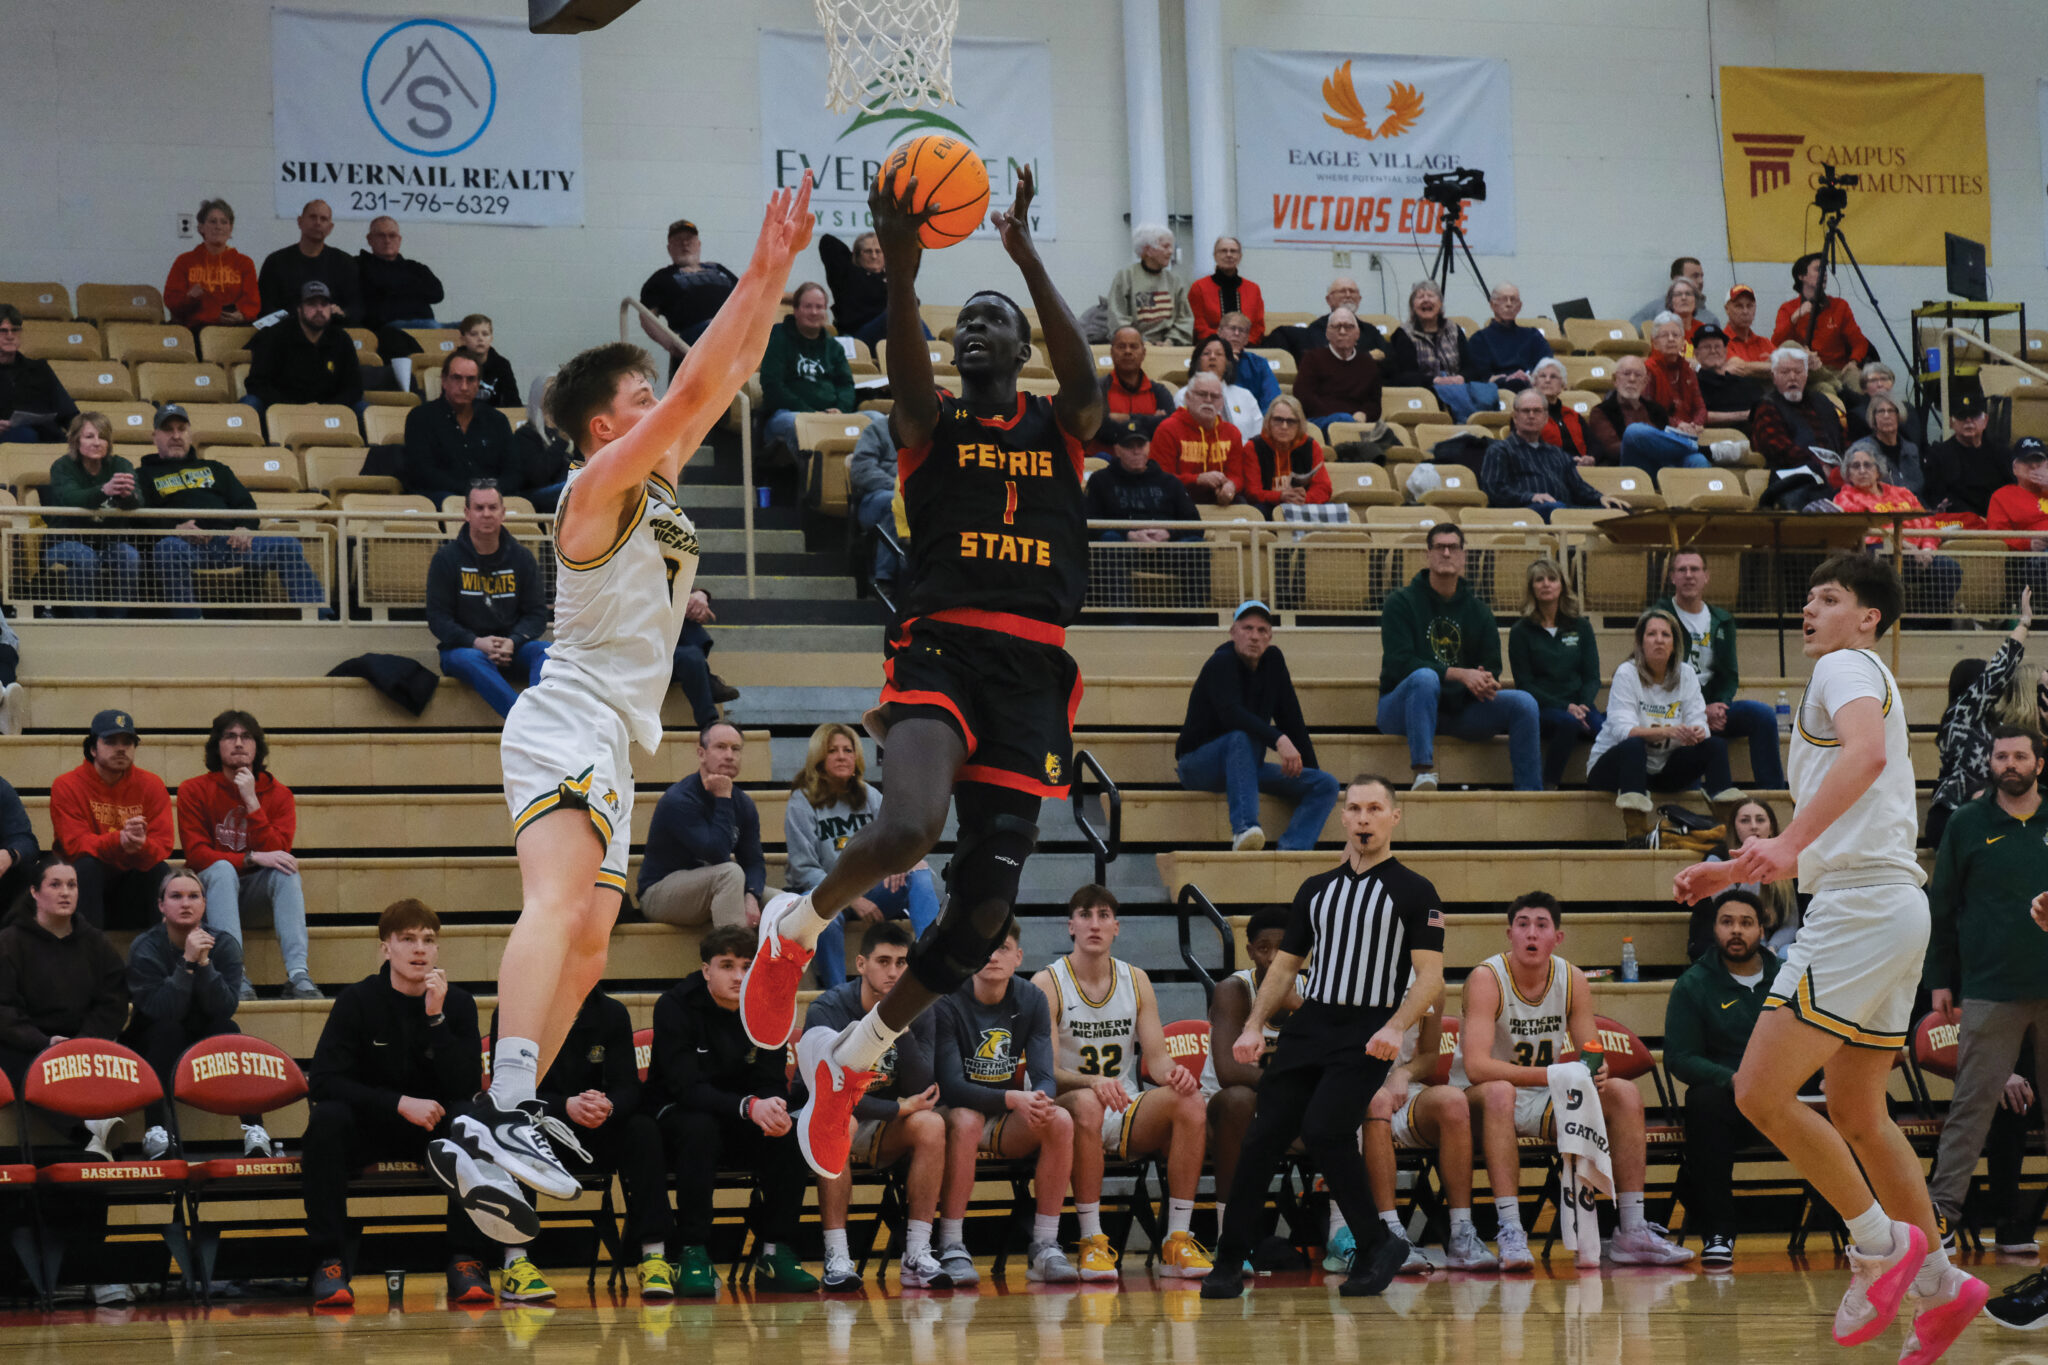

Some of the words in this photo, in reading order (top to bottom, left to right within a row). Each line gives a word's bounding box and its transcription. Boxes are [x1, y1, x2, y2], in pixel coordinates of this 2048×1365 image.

[406, 75, 452, 139] S
[1288, 149, 1360, 168] EAGLE
[1367, 152, 1461, 170] VILLAGE
[1806, 144, 1906, 167] CAMPUS
[281, 161, 455, 188] SILVERNAIL
[462, 167, 575, 192] REALTY
[776, 149, 1039, 196] EVEREN
[1316, 173, 1350, 183] WHERE
[1351, 174, 1402, 184] POTENTIAL
[1405, 176, 1424, 184] SOA
[351, 191, 510, 215] 231-796-6329
[1273, 194, 1392, 233] VICTORS
[268, 462, 277, 471] 10
[1711, 480, 1721, 490] 10
[1004, 481, 1018, 525] 1
[960, 531, 1051, 567] STATE
[1165, 1033, 1200, 1058] ERRIS
[1510, 1039, 1554, 1067] 34
[1598, 1030, 1634, 1055] TATE
[42, 1054, 92, 1085] FERRIS
[94, 1054, 139, 1084] STATE
[191, 1051, 240, 1083] FERRIS
[242, 1052, 287, 1081] STATE
[1078, 1043, 1123, 1078] 32
[1564, 1122, 1611, 1154] GATOR
[1645, 1132, 1686, 1143] ETBALL
[1900, 1125, 1940, 1136] ETBALL
[81, 1167, 165, 1180] BASKETBALL
[236, 1162, 302, 1176] BASKETBA
[378, 1161, 420, 1172] BASKE
